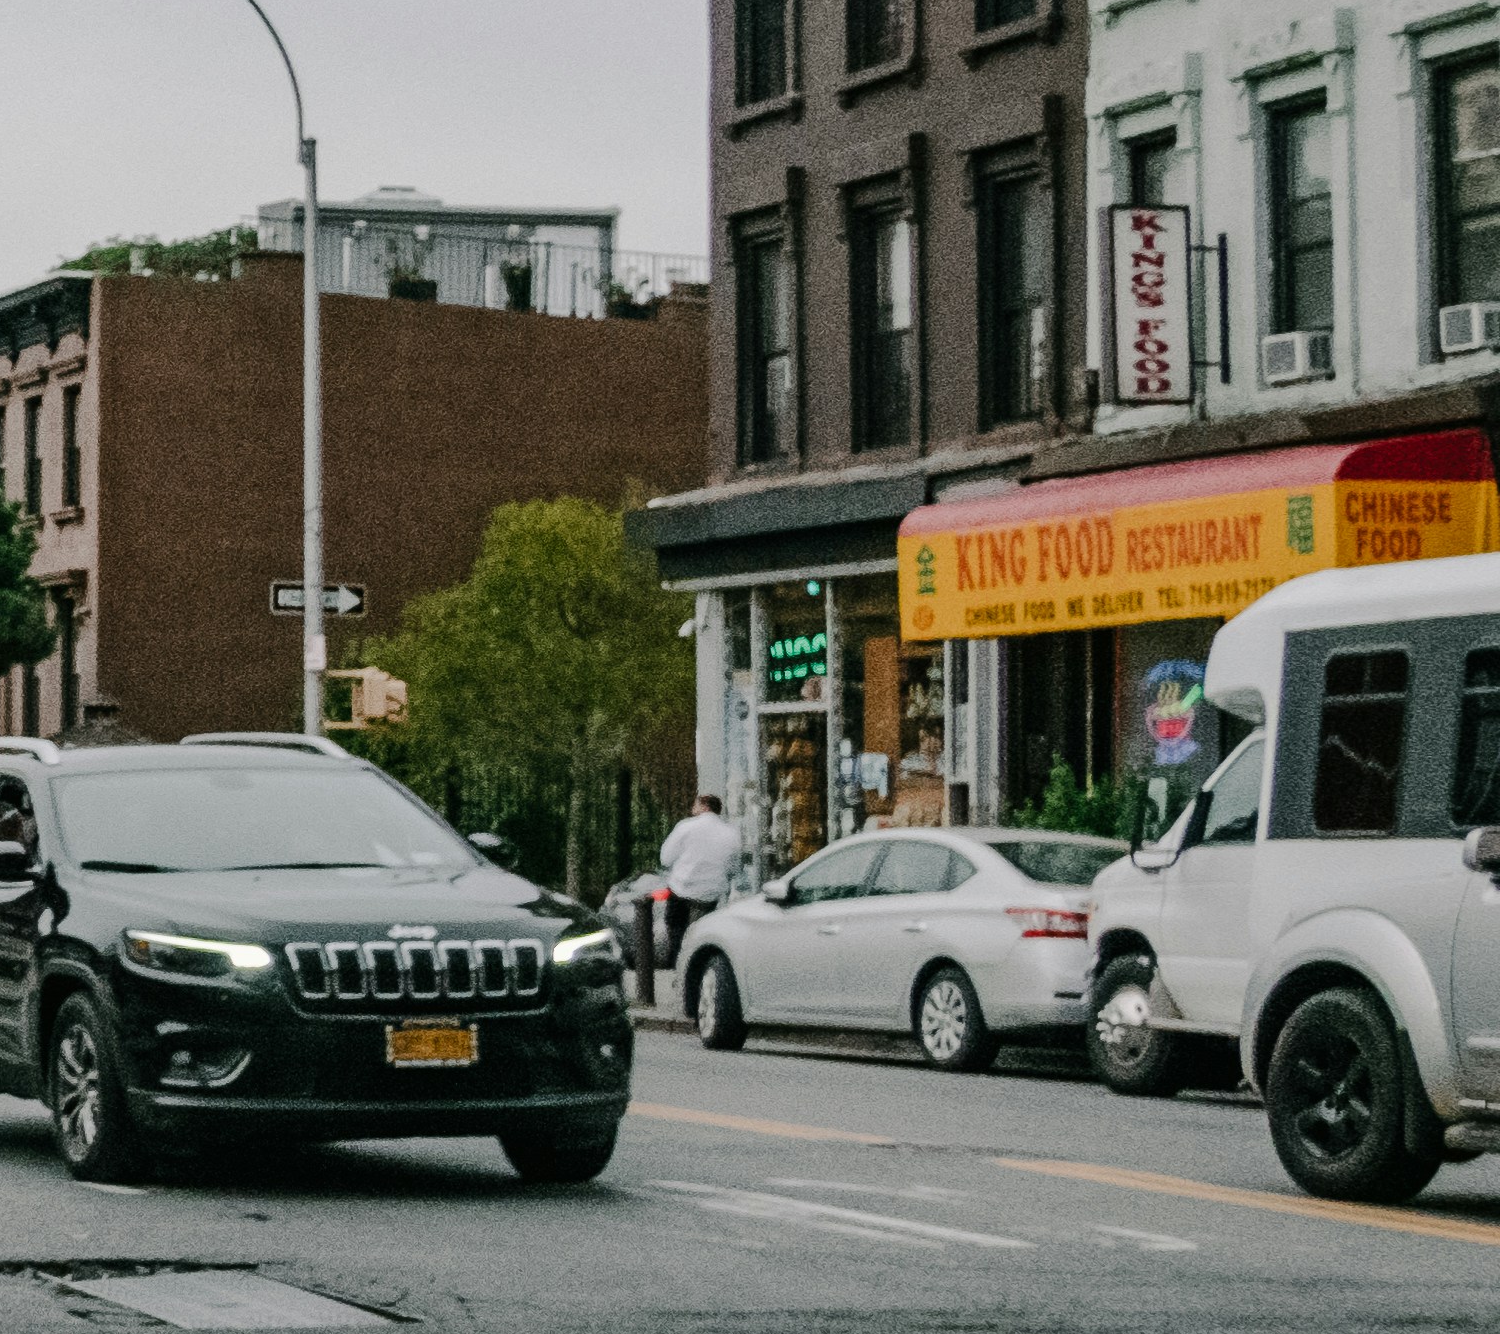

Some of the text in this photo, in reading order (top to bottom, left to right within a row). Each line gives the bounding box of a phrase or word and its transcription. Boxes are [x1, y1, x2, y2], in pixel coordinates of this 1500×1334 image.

[1133, 318, 1172, 395] FOOD
[1344, 490, 1453, 525] CHINESE
[955, 528, 1028, 592] KING
[1036, 517, 1115, 583] FOOD
[1126, 515, 1262, 574] RESTAURANT
[1356, 527, 1422, 560] FOOD
[964, 602, 1016, 627] CHINESE
[1023, 599, 1056, 622] FOOD
[1066, 595, 1086, 618] WE
[1092, 589, 1144, 617] DELIVER
